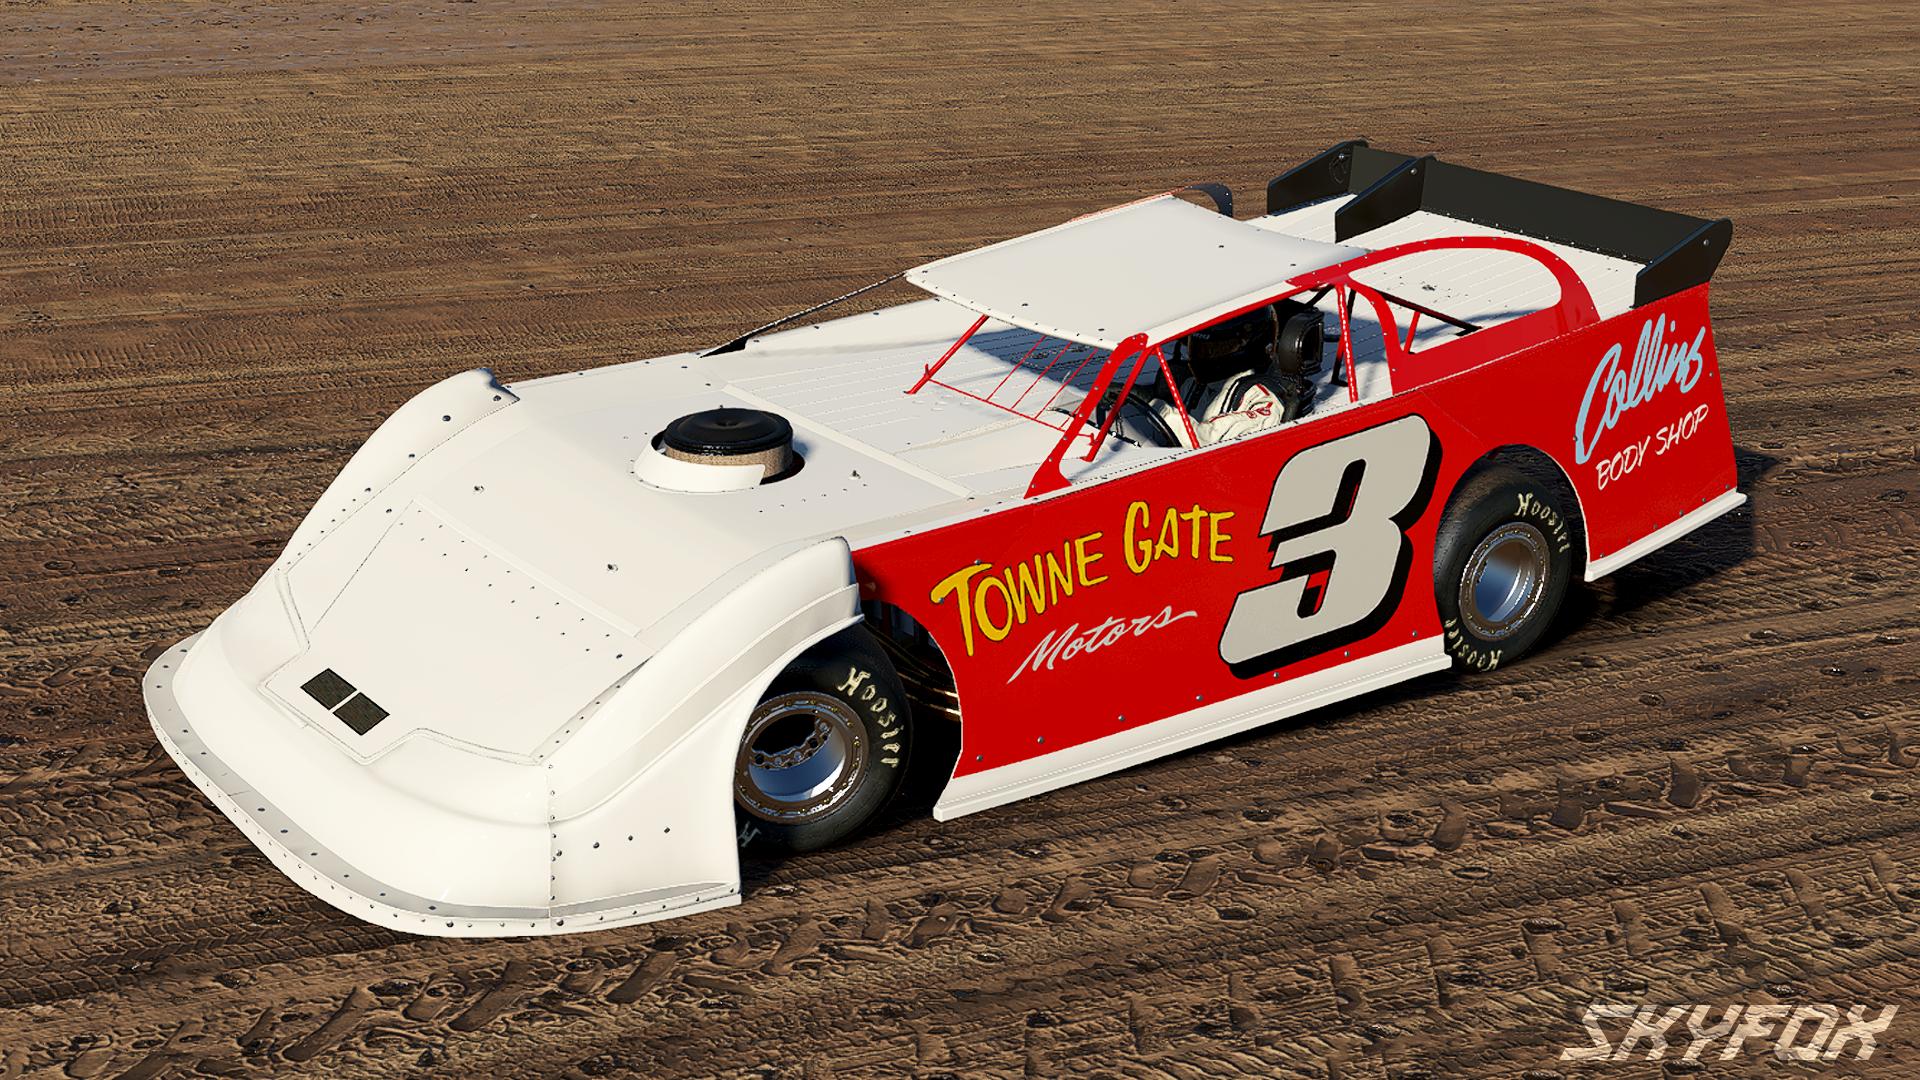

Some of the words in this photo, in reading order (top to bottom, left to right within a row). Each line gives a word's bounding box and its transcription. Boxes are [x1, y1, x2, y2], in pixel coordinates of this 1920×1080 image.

[1574, 312, 1708, 465] Collins
[1595, 434, 1651, 492] BODY
[1654, 403, 1710, 457] SHOP
[930, 532, 1108, 657] TOWNE
[1122, 500, 1236, 575] GATE
[1218, 413, 1444, 680] 3
[1006, 605, 1199, 685] Motors
